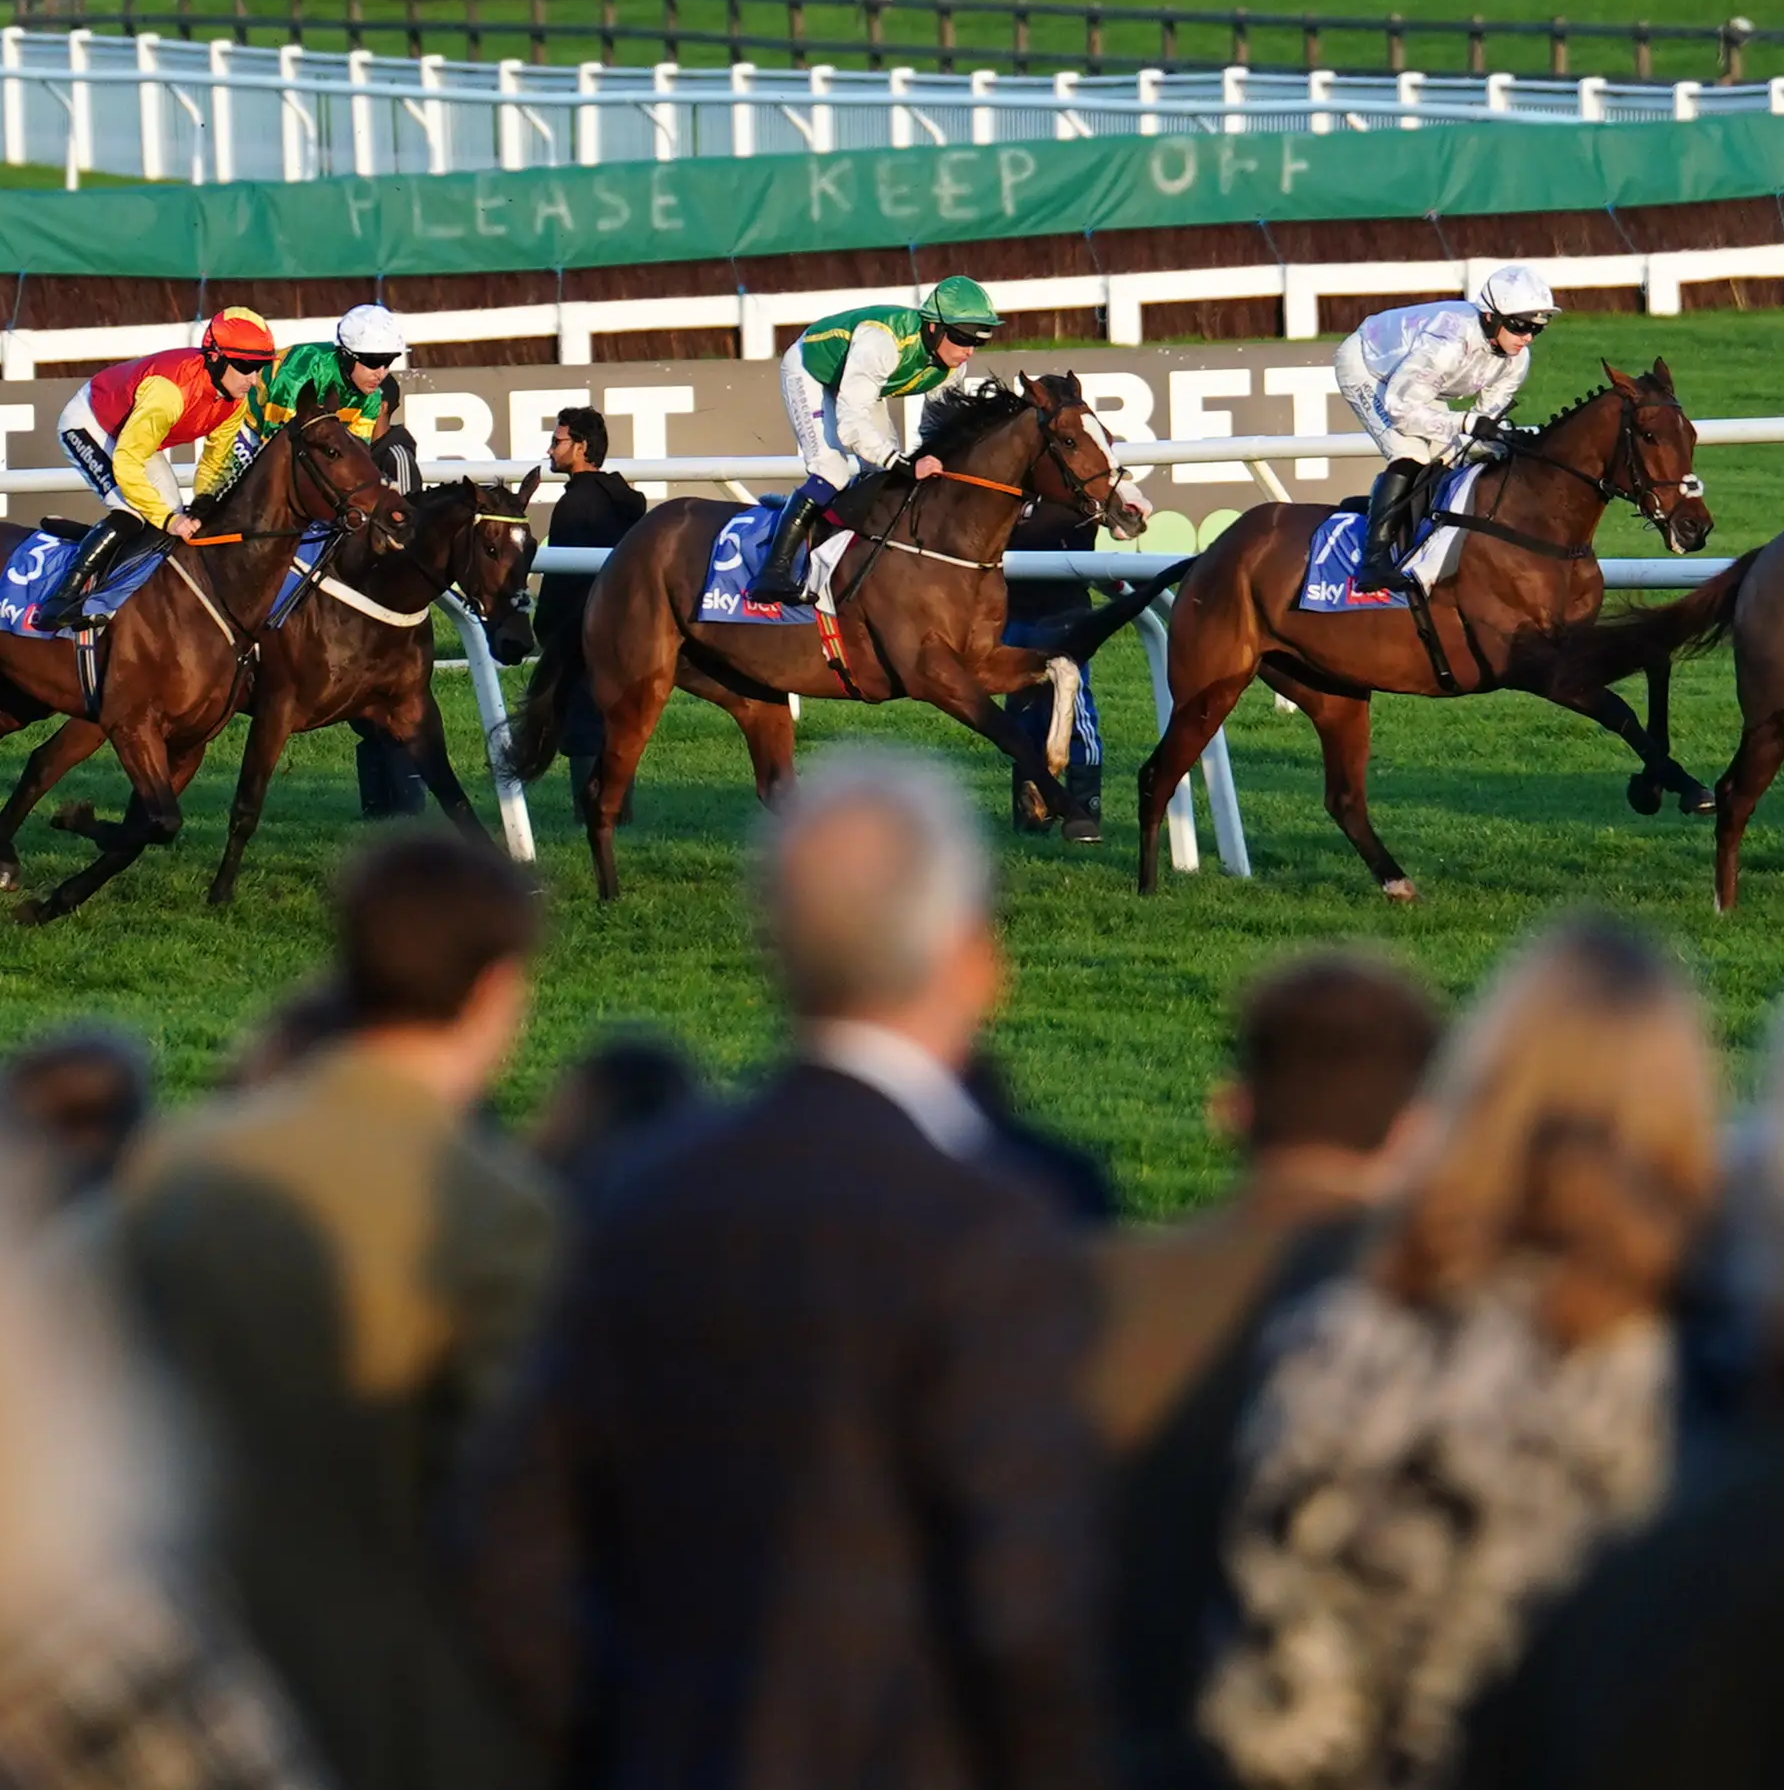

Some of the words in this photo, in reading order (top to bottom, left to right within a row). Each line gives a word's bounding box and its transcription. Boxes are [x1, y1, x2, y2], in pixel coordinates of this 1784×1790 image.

[343, 165, 684, 239] PLEASE
[809, 148, 1035, 221] KEEP
[1150, 135, 1313, 195] OFF
[7, 532, 61, 585] 3
[713, 516, 756, 571] 5
[701, 588, 741, 615] sky
[1307, 580, 1345, 604] sky
